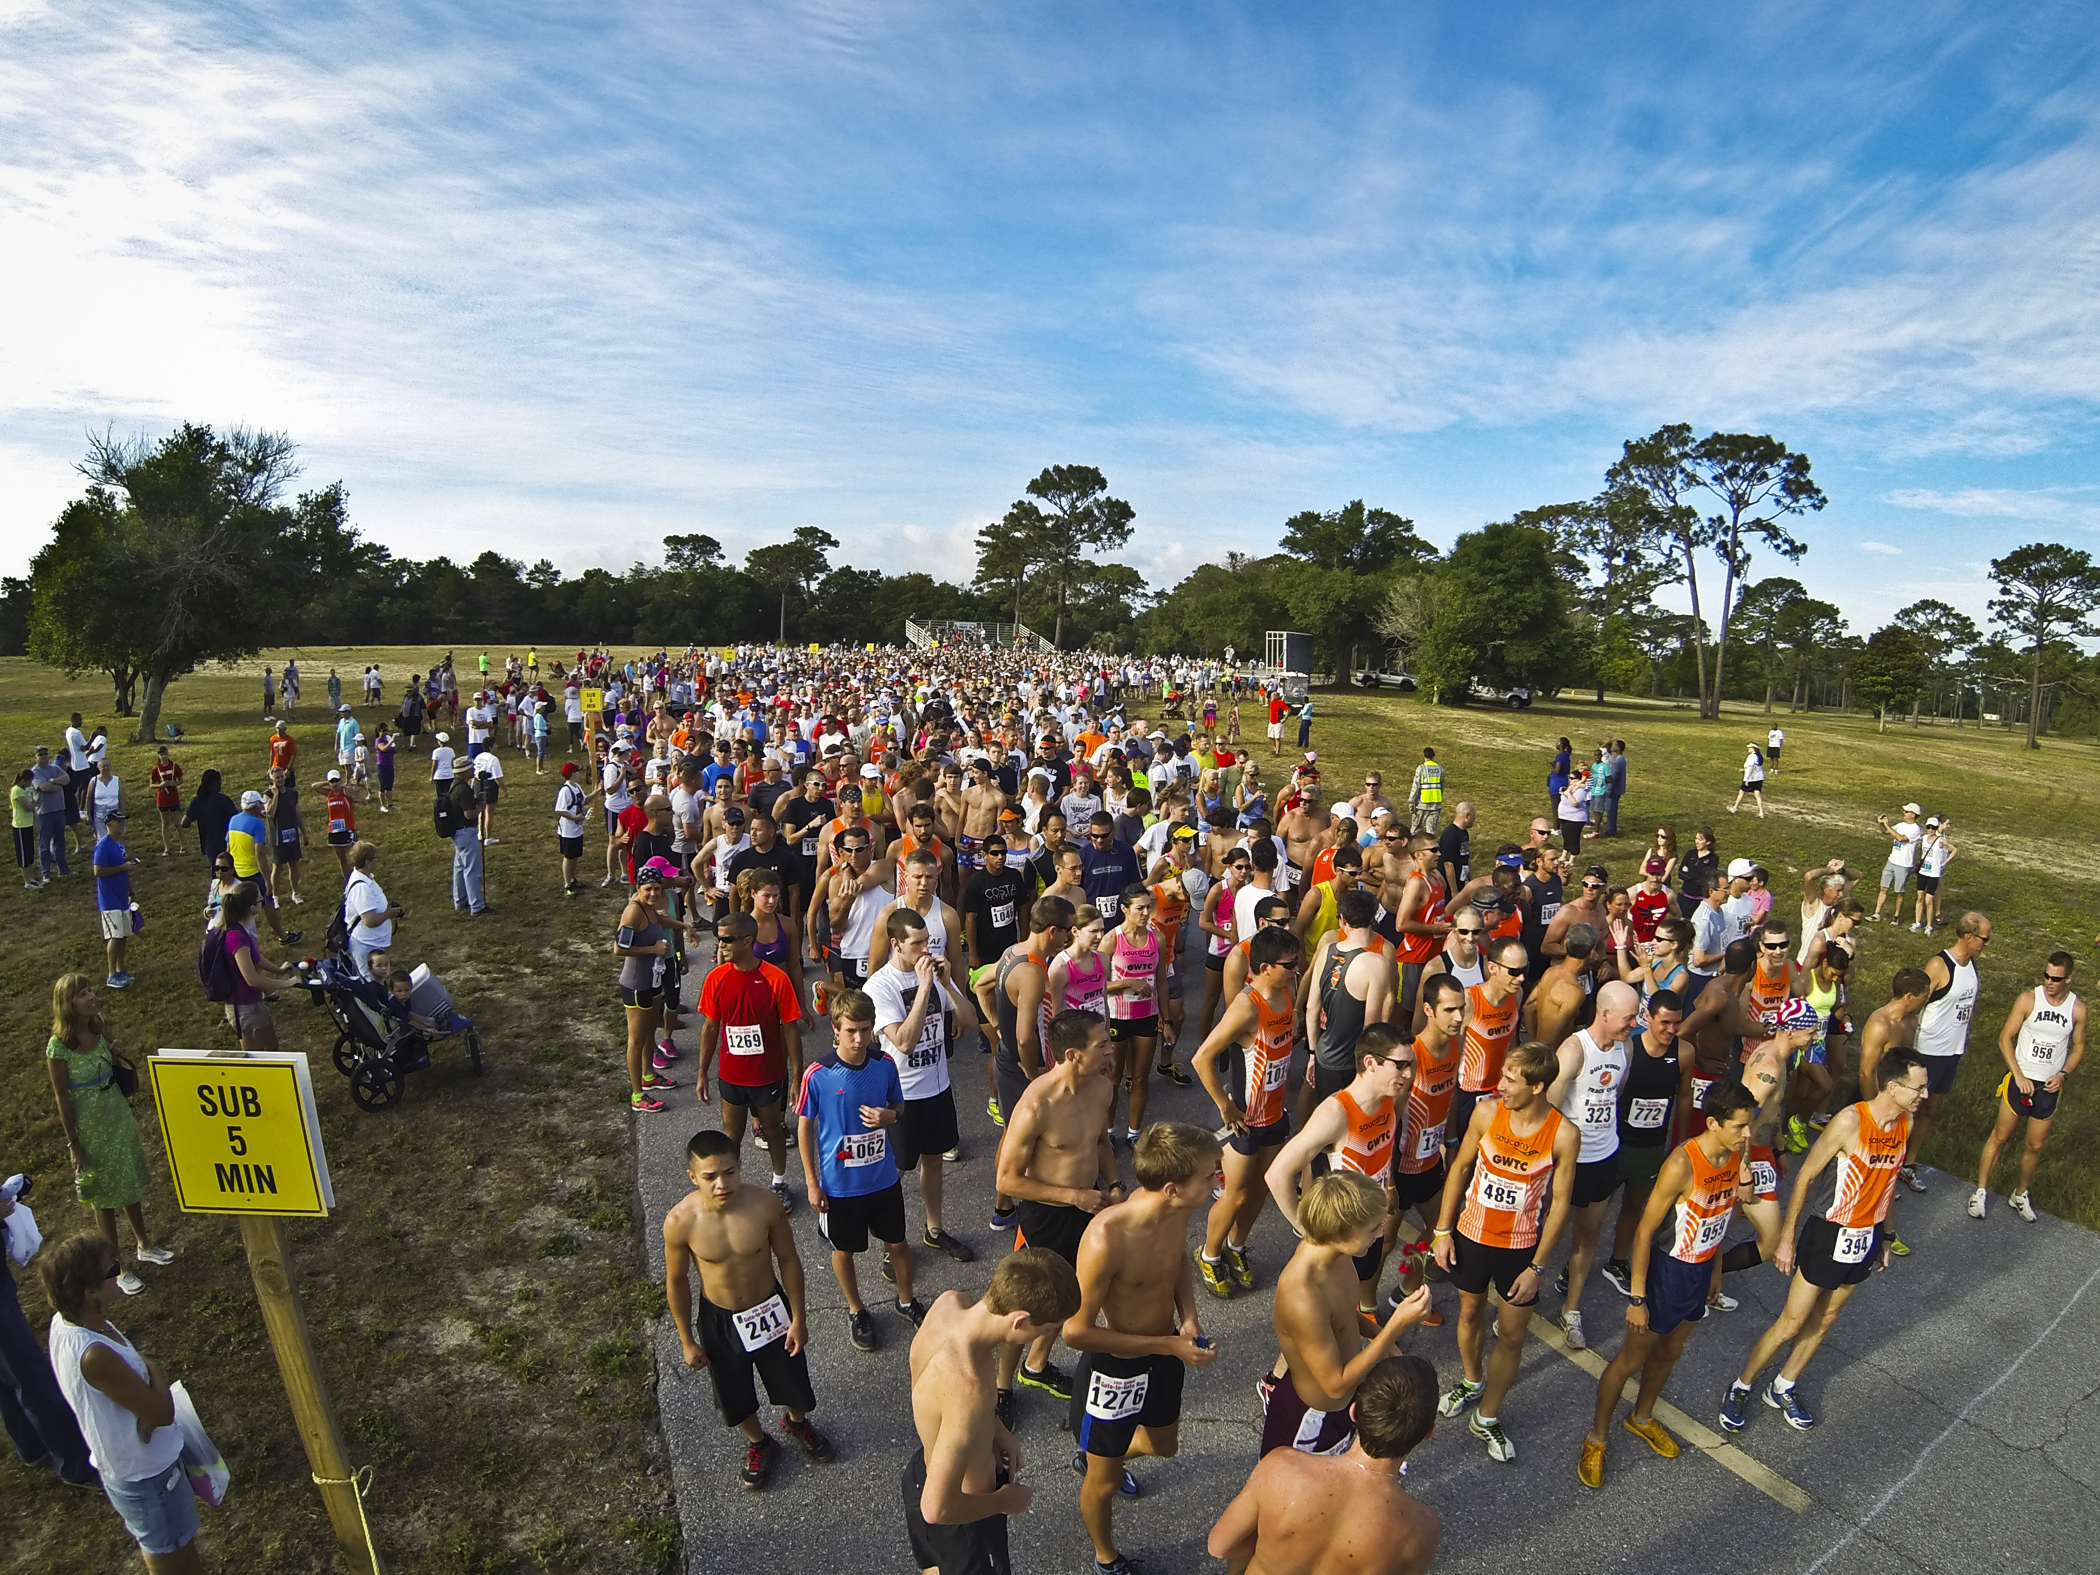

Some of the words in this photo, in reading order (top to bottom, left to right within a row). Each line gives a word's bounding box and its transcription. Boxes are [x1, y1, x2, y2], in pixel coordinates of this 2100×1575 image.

[985, 884, 1018, 899] COSTA
[1127, 963, 1153, 971] GWTC
[1083, 988, 1104, 1000] GWTC
[1763, 996, 1783, 1004] GWTC
[2034, 1010, 2068, 1028] ARMY
[1273, 1028, 1293, 1046] GWTC
[1488, 1024, 1511, 1036] GWTC
[729, 1033, 761, 1049] 1269
[2031, 1045, 2053, 1060] 958
[1589, 1064, 1604, 1075] GULF
[1430, 1077, 1454, 1094] GWTC
[197, 1084, 262, 1118] SUB
[1585, 1106, 1612, 1124] 323
[1634, 1107, 1662, 1122] 772
[227, 1126, 248, 1157] 5
[846, 1138, 885, 1160] 1062
[1366, 1129, 1391, 1151] GWTC
[1495, 1133, 1531, 1151] saucony
[1492, 1154, 1529, 1172] GWTC
[214, 1163, 278, 1194] MIN
[1484, 1183, 1518, 1205] 485
[1707, 1187, 1733, 1205] GWTC
[1700, 1218, 1727, 1244] 959
[1841, 1236, 1869, 1255] 394
[744, 1309, 783, 1341] 241
[1090, 1385, 1146, 1410] 1276
